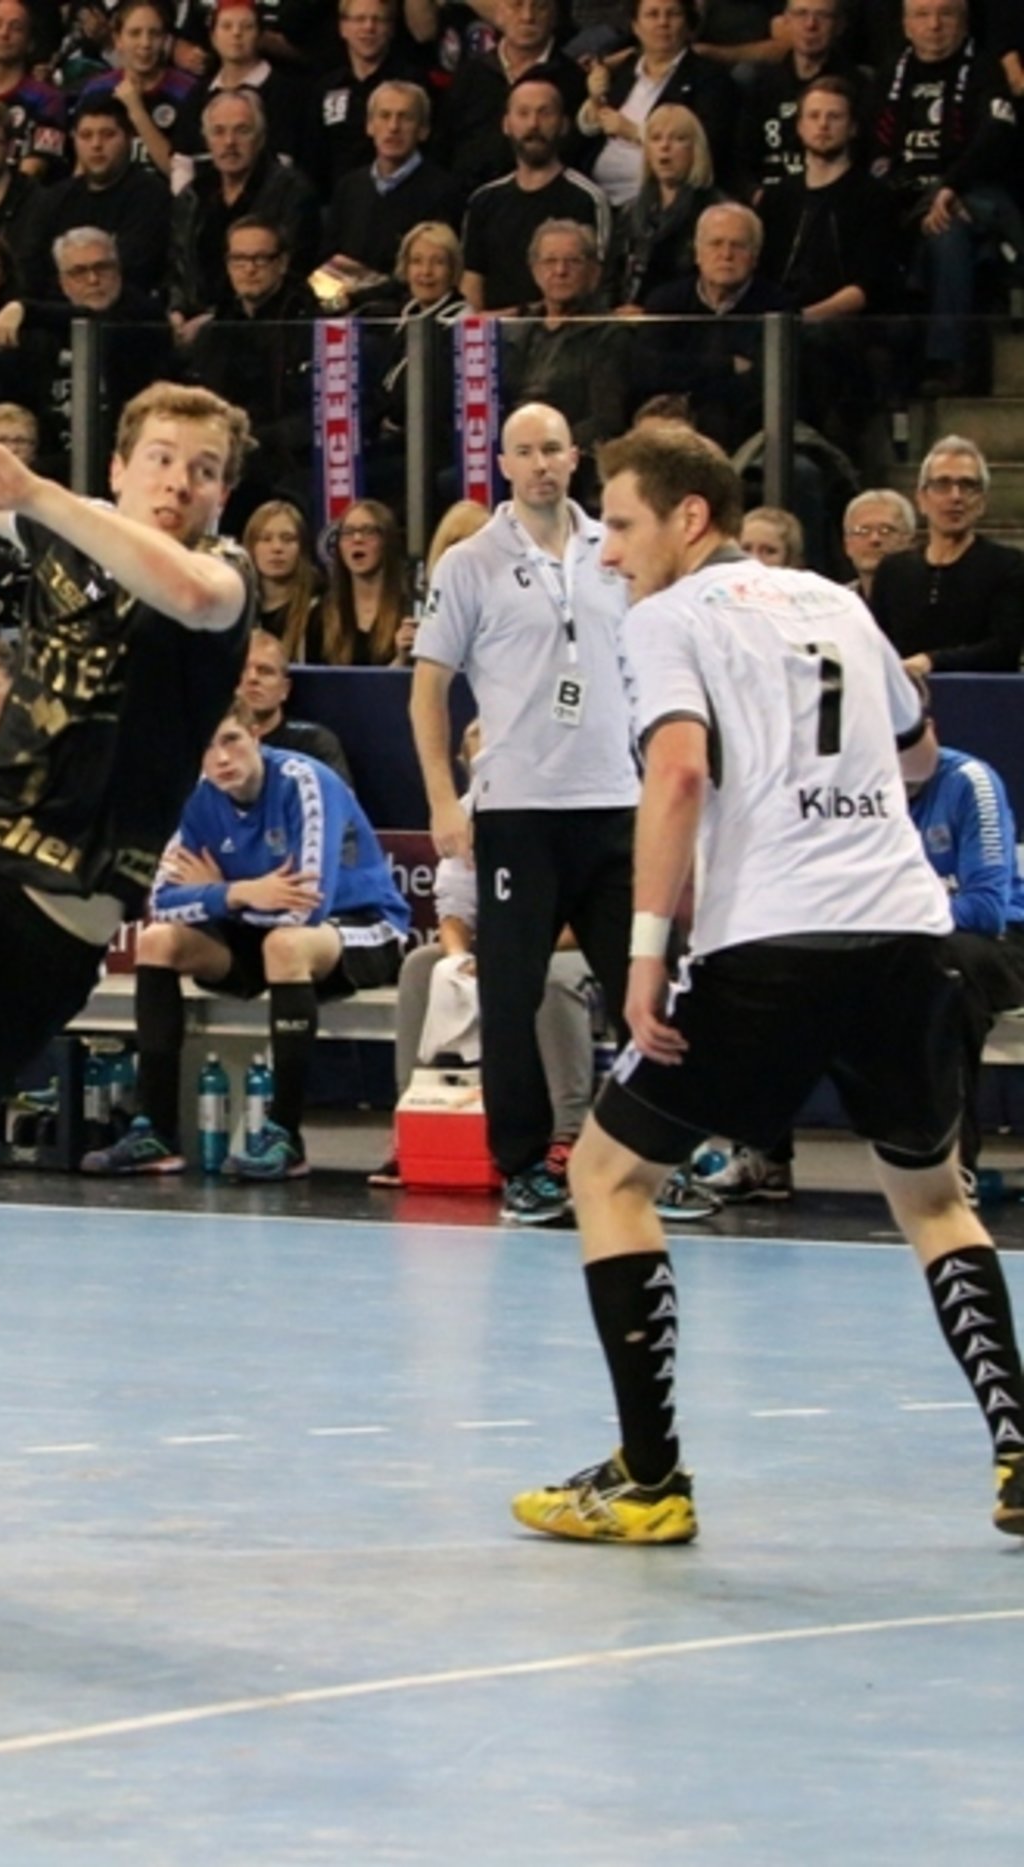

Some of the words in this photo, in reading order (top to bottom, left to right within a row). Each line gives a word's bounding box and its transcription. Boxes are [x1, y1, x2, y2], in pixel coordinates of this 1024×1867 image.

[327, 433, 352, 498] HC
[466, 417, 489, 485] HC
[557, 681, 582, 706] B
[798, 788, 888, 819] Kibat
[494, 867, 512, 901] C
